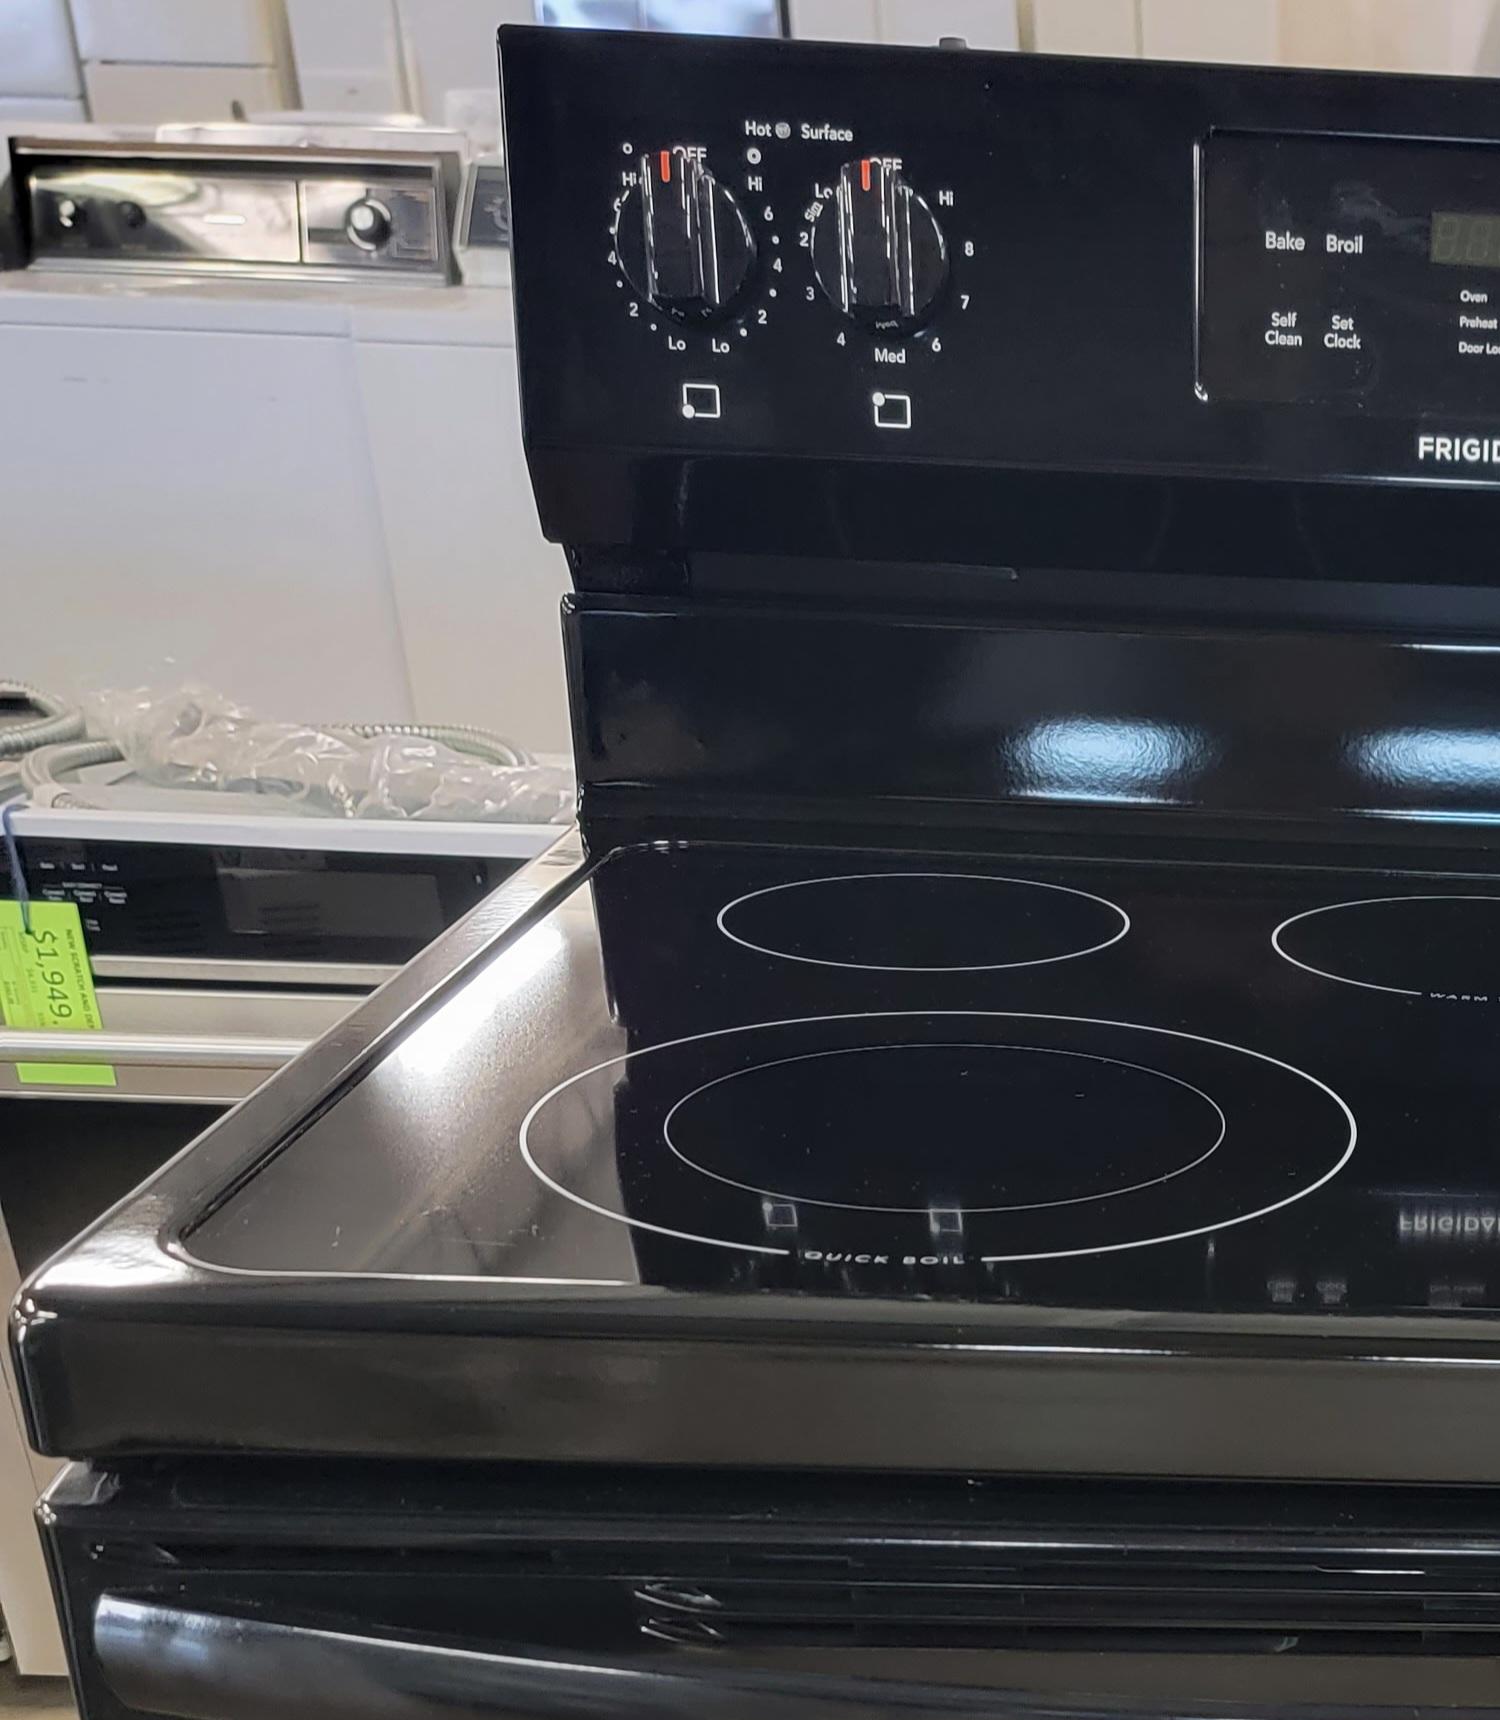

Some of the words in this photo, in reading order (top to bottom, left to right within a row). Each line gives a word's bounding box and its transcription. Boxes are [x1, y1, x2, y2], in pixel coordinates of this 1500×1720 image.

[745, 120, 772, 137] Hot
[801, 123, 854, 142] Surface
[622, 171, 637, 187] Hi
[748, 176, 763, 192] Hi
[939, 190, 954, 207] Hi
[764, 205, 774, 221] 6
[804, 201, 823, 222] Sim
[799, 231, 809, 247] 2
[1265, 231, 1305, 251] Bake
[1326, 234, 1363, 254] Broil
[964, 241, 975, 257] 8
[607, 251, 617, 265] 4
[772, 258, 783, 272] 4
[806, 286, 815, 301] 3
[1460, 290, 1488, 303] Oven
[629, 302, 639, 317] 2
[960, 294, 970, 310] 7
[757, 309, 767, 325] 2
[1271, 312, 1298, 328] Self
[1331, 315, 1354, 330] Set
[1459, 316, 1498, 330] Preheat
[668, 335, 687, 351] Lo
[712, 338, 730, 353] Lo
[837, 332, 846, 346] 4
[932, 337, 942, 352] 6
[1264, 330, 1302, 347] Clean
[1324, 333, 1361, 350] Clock
[874, 347, 906, 364] Med
[1458, 342, 1484, 355] Door
[32, 929, 73, 1026] $1,949.
[1430, 992, 1488, 1001] WARM
[804, 1250, 889, 1264] QUICK
[902, 1255, 966, 1265] BOIL
